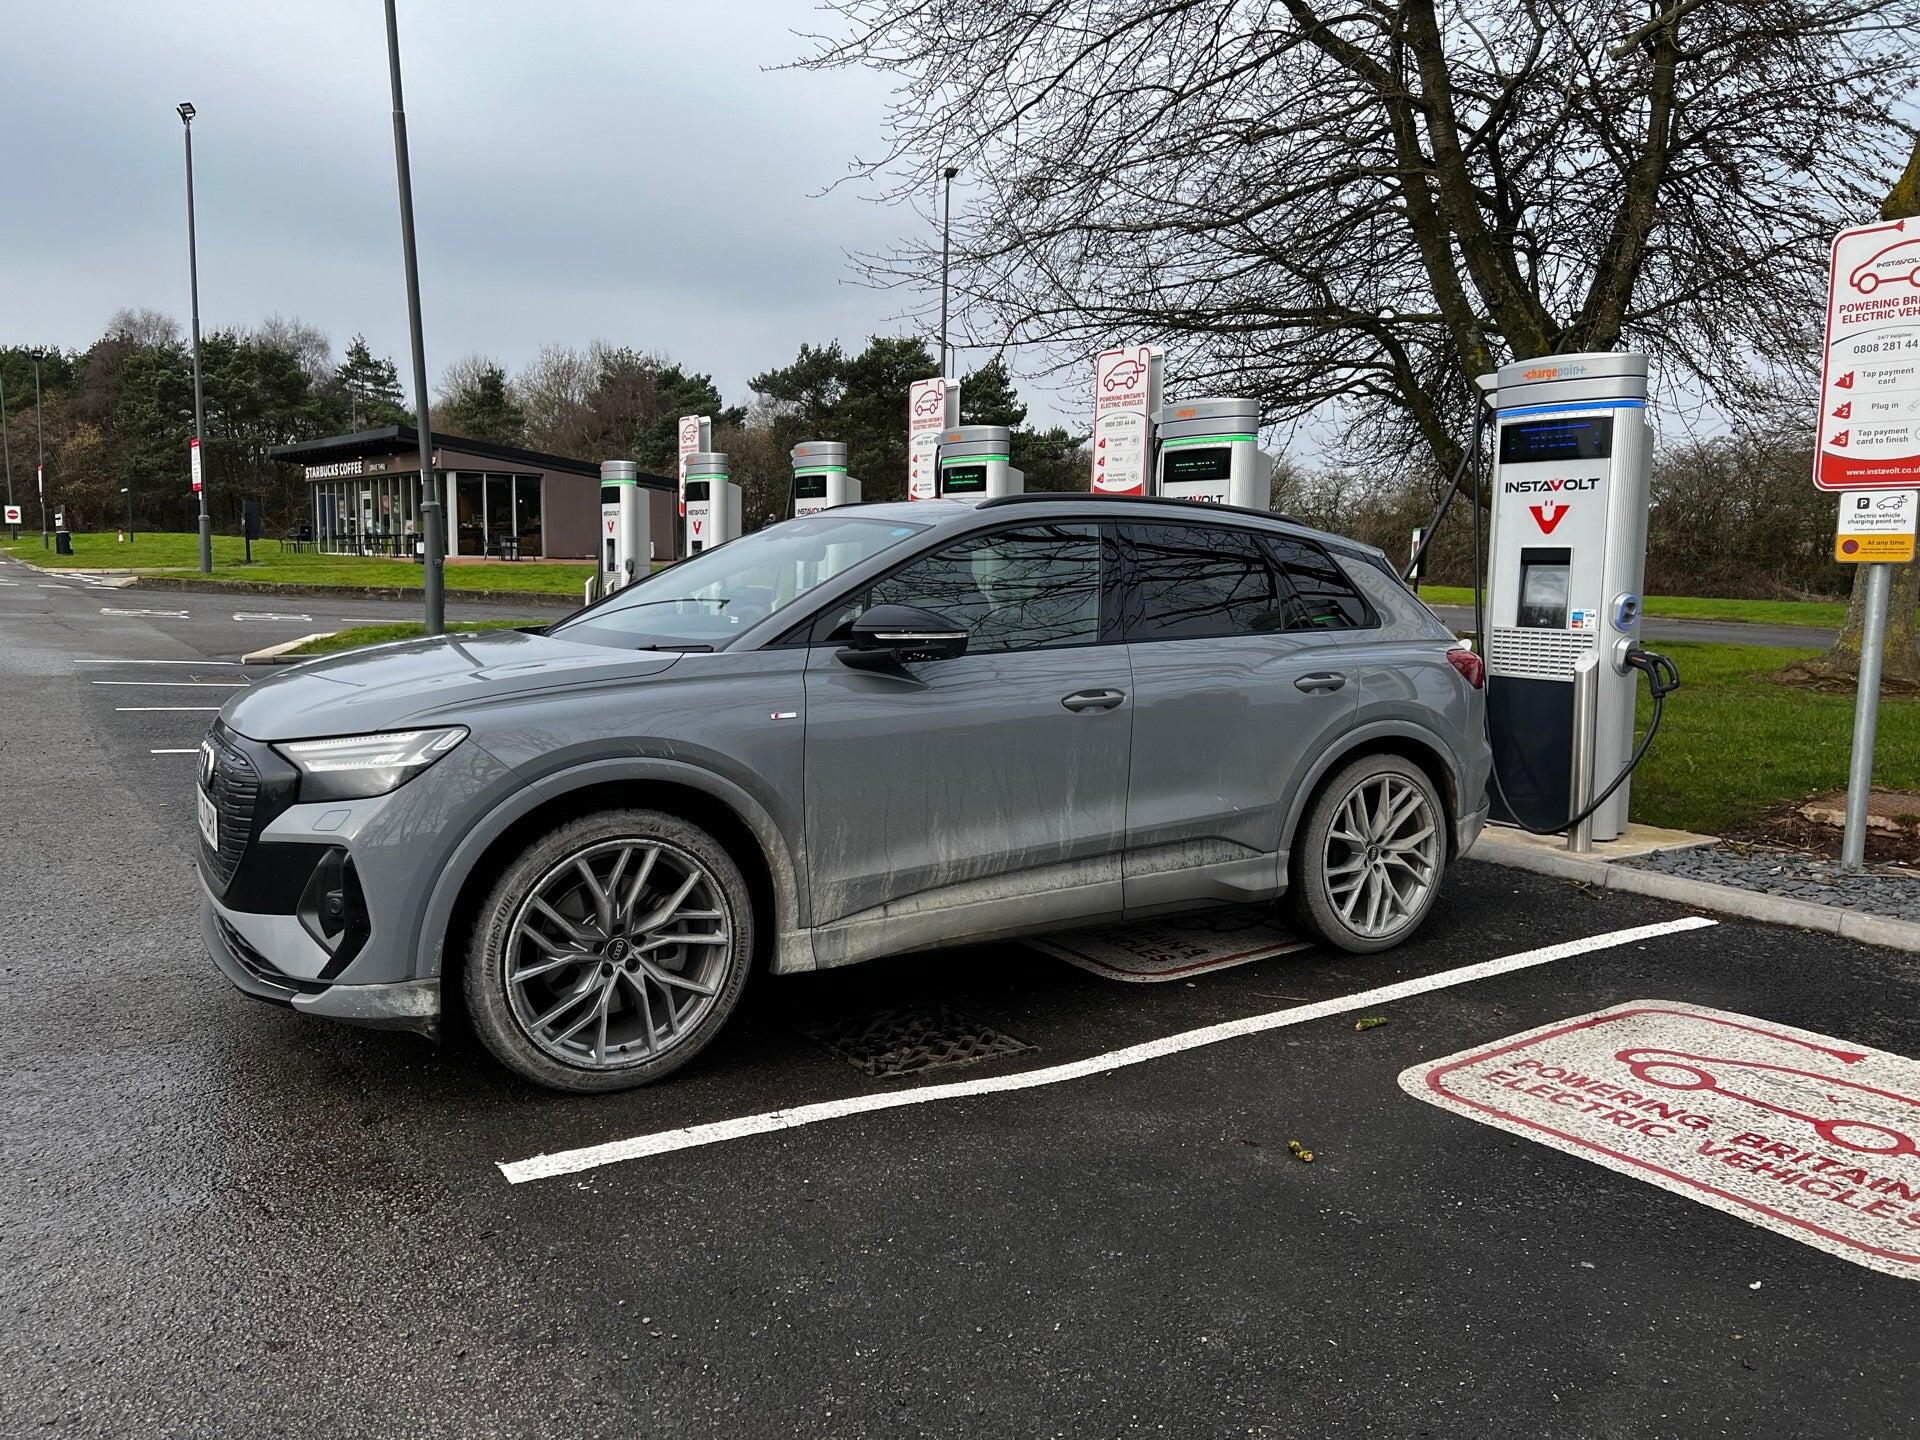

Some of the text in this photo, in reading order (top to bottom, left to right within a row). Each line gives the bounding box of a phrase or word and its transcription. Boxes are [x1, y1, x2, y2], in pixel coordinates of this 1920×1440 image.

[1839, 297, 1899, 314] POWERING
[1842, 310, 1894, 324] ELECTRIC
[1854, 343, 1879, 354] 0808
[1882, 341, 1901, 351] 281
[1878, 367, 1914, 377] payment
[1878, 377, 1896, 385] card
[1842, 407, 1848, 416] 2
[1871, 402, 1889, 411] Plug
[1858, 427, 1908, 437] Tap payment
[1840, 435, 1846, 444] 3
[1856, 437, 1874, 445] card
[1886, 435, 1909, 443] finish
[305, 461, 362, 479] STARBUCKS COFFEE
[1505, 478, 1600, 493] INSTAVOLT
[1173, 494, 1224, 504] AVOLT
[1509, 1058, 1713, 1133] POWERING
[1482, 1070, 1677, 1138] ELECTRIC
